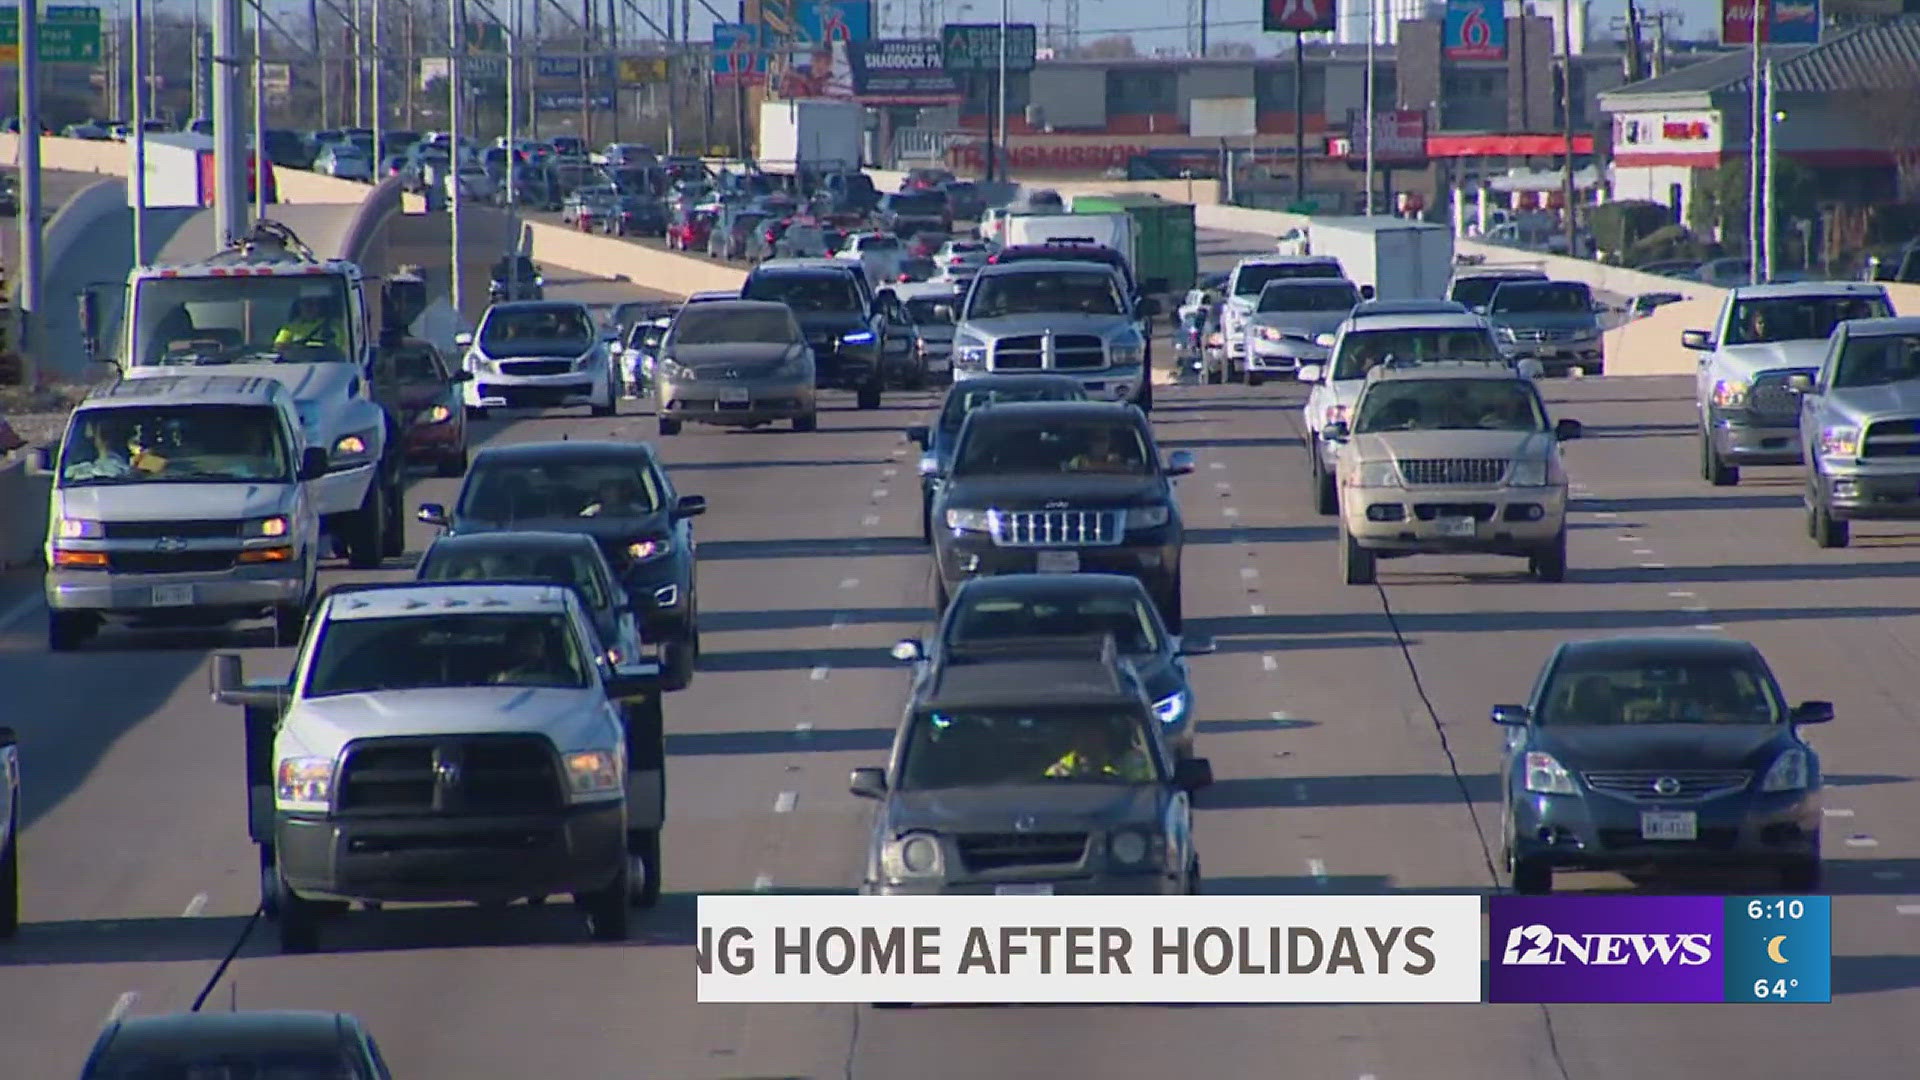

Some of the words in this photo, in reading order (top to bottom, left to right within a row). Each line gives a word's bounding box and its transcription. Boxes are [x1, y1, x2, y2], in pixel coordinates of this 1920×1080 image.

[1461, 6, 1491, 49] 6
[926, 53, 944, 69] PA
[949, 144, 1148, 170] TRNSMISSION
